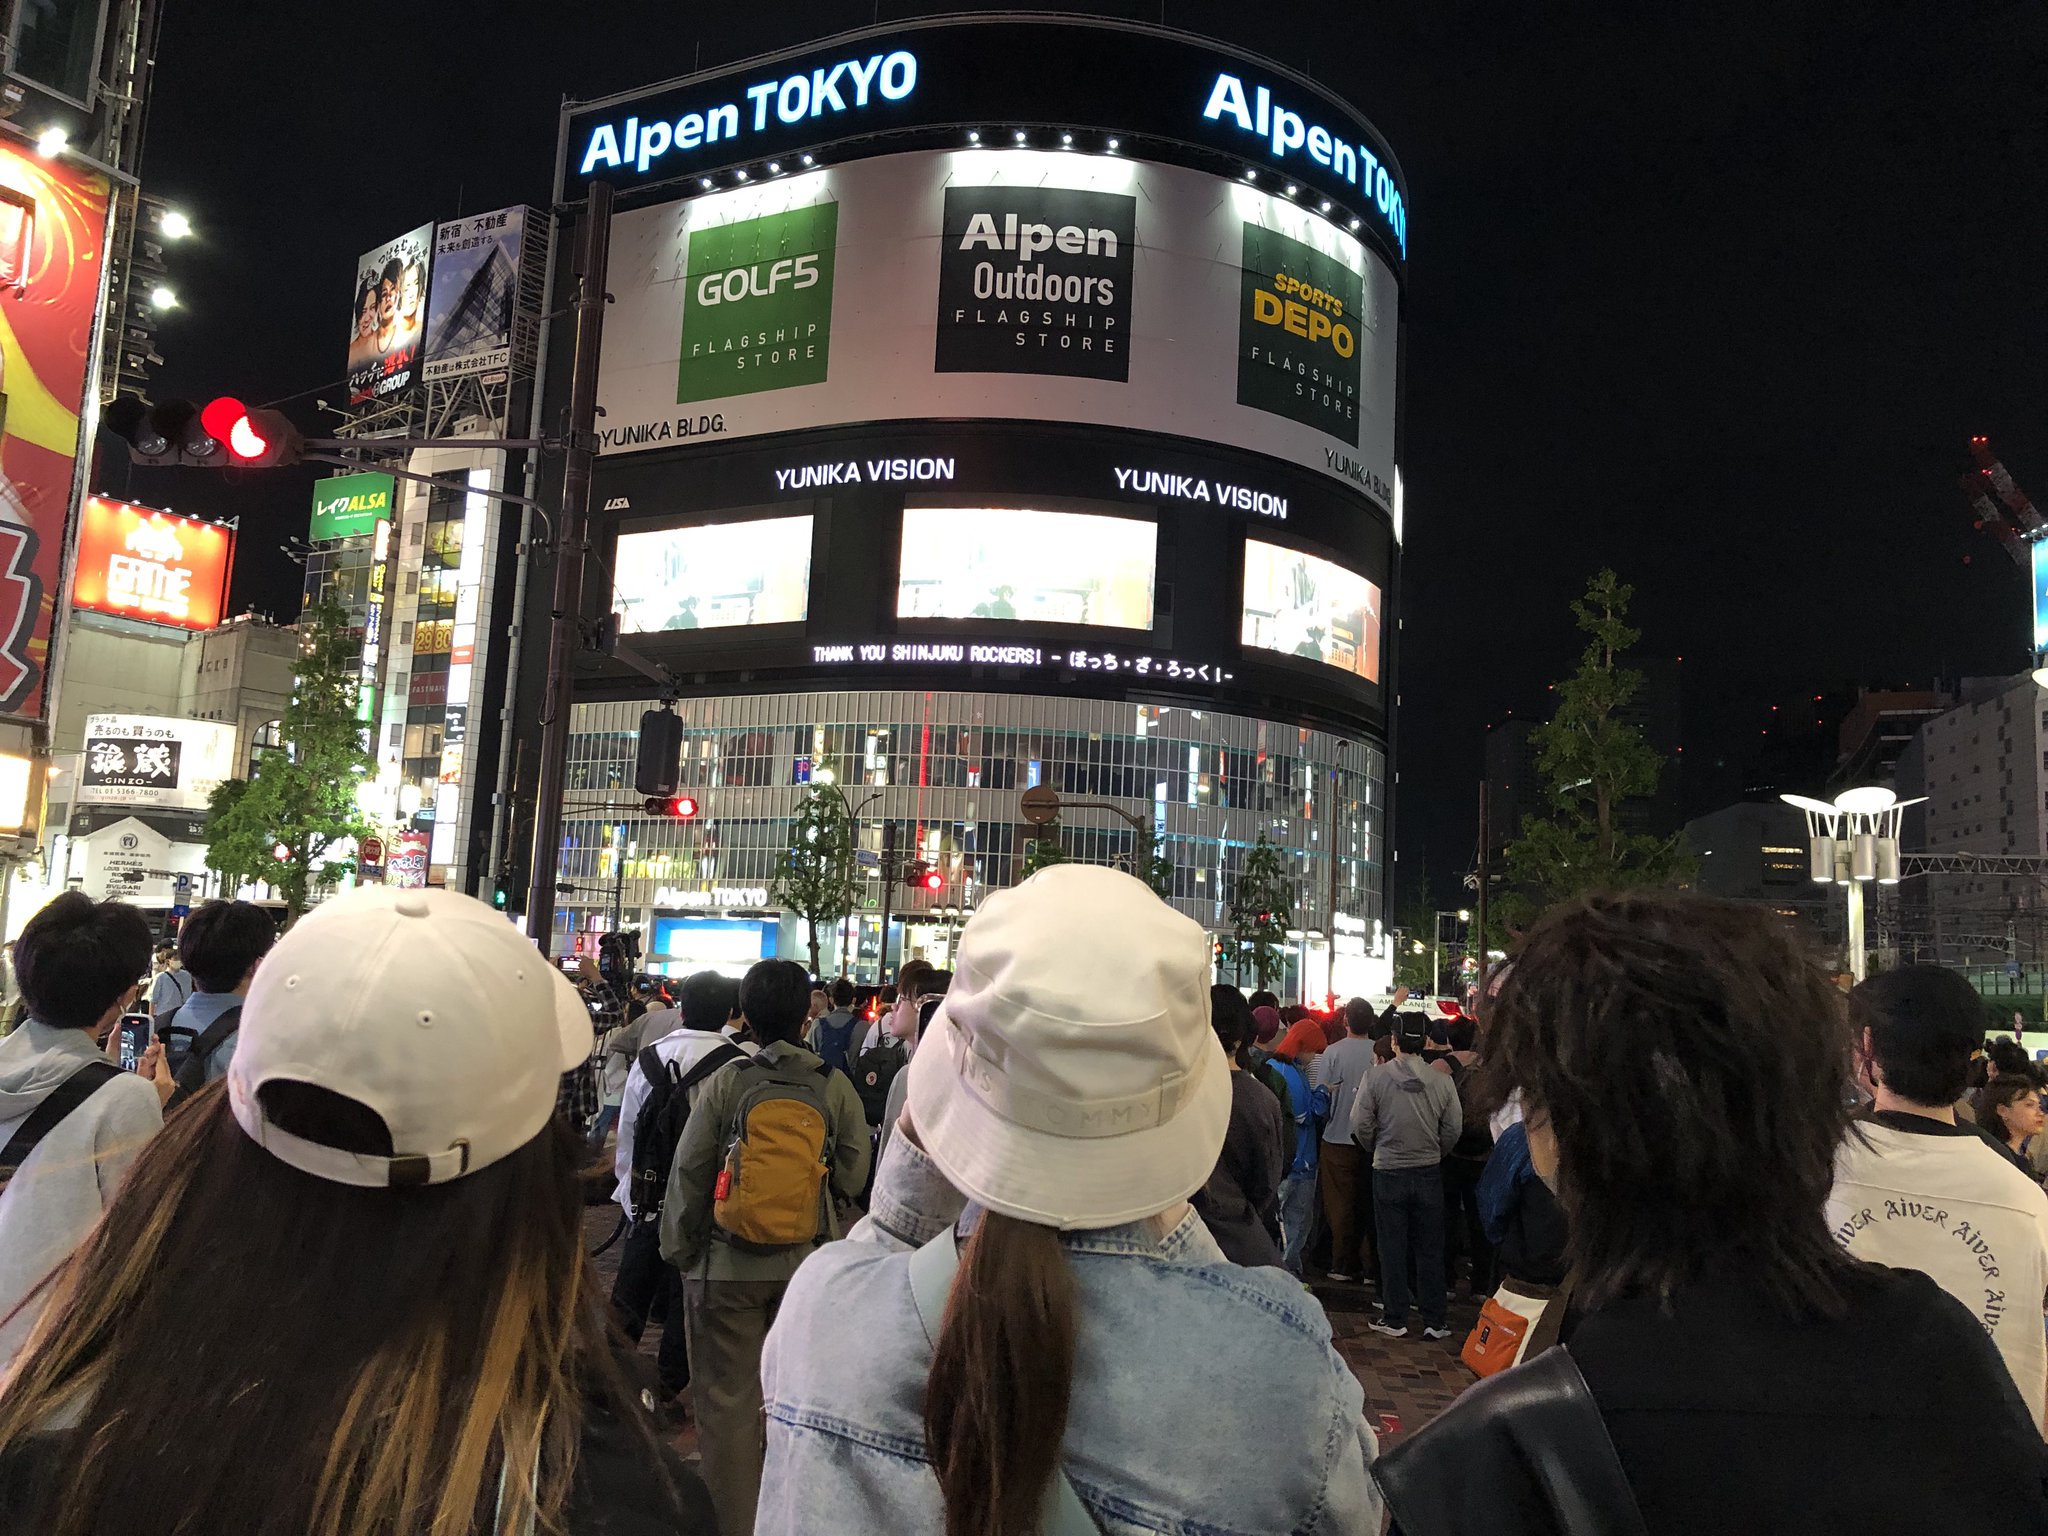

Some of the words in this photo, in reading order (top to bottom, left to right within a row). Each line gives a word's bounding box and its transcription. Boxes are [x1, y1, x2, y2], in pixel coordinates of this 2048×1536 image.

[579, 103, 739, 173] Alpen
[747, 50, 917, 131] TOKYO
[1203, 73, 1357, 184] Alpen
[1360, 145, 1406, 261] TOKY
[959, 213, 1118, 261] Alpen
[697, 254, 820, 307] GOLF5
[975, 262, 1114, 306] Outdoors
[1275, 273, 1344, 316] SPORTS
[956, 310, 1116, 330] FLAGSHIP
[1254, 289, 1355, 359] DEPO
[693, 324, 818, 357] FLAGSHIP
[737, 345, 816, 370] STORE
[1016, 333, 1115, 353] STORE
[380, 371, 411, 395] GROUP
[1252, 347, 1355, 397] FLAGSHIP
[1296, 383, 1353, 419] STORE
[600, 420, 671, 448] YUNIKA
[677, 414, 728, 437] BLDG.
[775, 462, 861, 490] YUNIKA
[867, 458, 955, 482] VISION
[1324, 447, 1372, 487] YUNIKA
[1114, 467, 1210, 502] YUNIKA
[1215, 483, 1288, 519] VISION
[814, 646, 854, 662] THANK
[860, 646, 886, 661] YOU
[893, 645, 964, 662] SHINJUKU
[970, 646, 1041, 665] ROCKERS!
[711, 887, 768, 908] TOKYO
[1378, 998, 1433, 1010] AMLANCE
